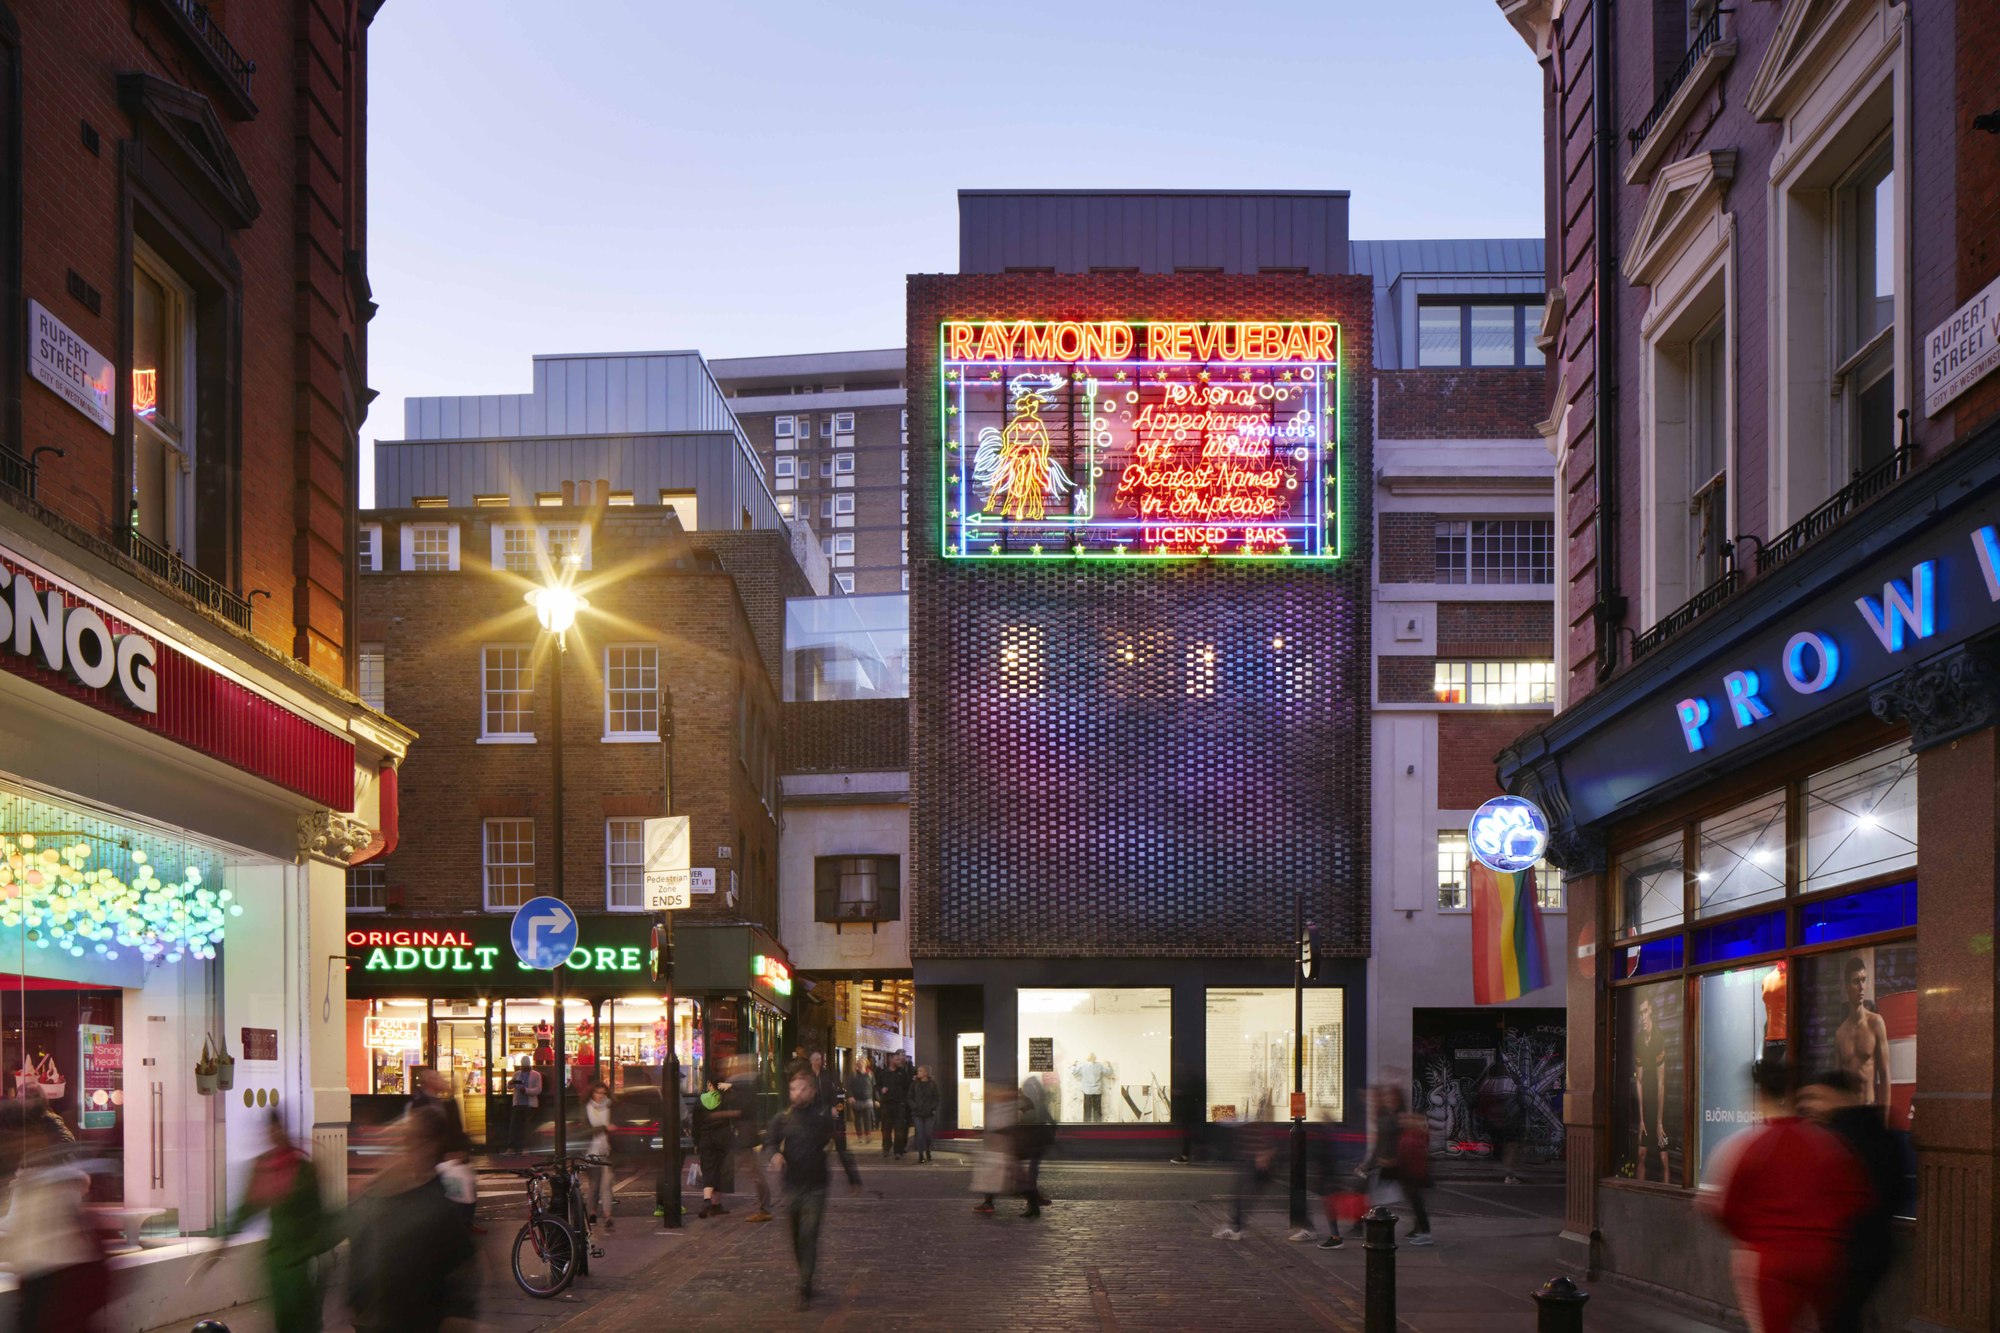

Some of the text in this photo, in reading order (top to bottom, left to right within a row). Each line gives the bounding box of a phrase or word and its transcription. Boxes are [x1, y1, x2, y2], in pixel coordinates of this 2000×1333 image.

[1933, 294, 1990, 359] RUPERT
[40, 313, 89, 367] RUPERT
[949, 320, 1334, 361] RAYMOND REVUEBAR
[40, 338, 88, 388] STREET
[1933, 324, 1986, 384] STREET
[40, 368, 105, 423] CITY OF WESTMINSTER
[1164, 382, 1256, 407] Personal
[1933, 389, 1948, 408] CITY
[1949, 383, 1960, 396] OF
[1132, 404, 1269, 438] Appearances
[1238, 425, 1316, 437] FABULOUS
[1202, 432, 1270, 458] Worlds
[1118, 461, 1283, 491] Greatest Names
[1170, 488, 1276, 521] Striptease
[1145, 527, 1287, 544] LICENSED BARS
[646, 873, 688, 884] Pedestrian
[658, 884, 677, 894] Zone
[652, 895, 683, 907] ENDS
[346, 931, 473, 946] ORIGINAL
[365, 946, 498, 971] ADULT
[95, 1057, 120, 1066] heart
[1705, 1107, 1735, 1122] BJÖRN
